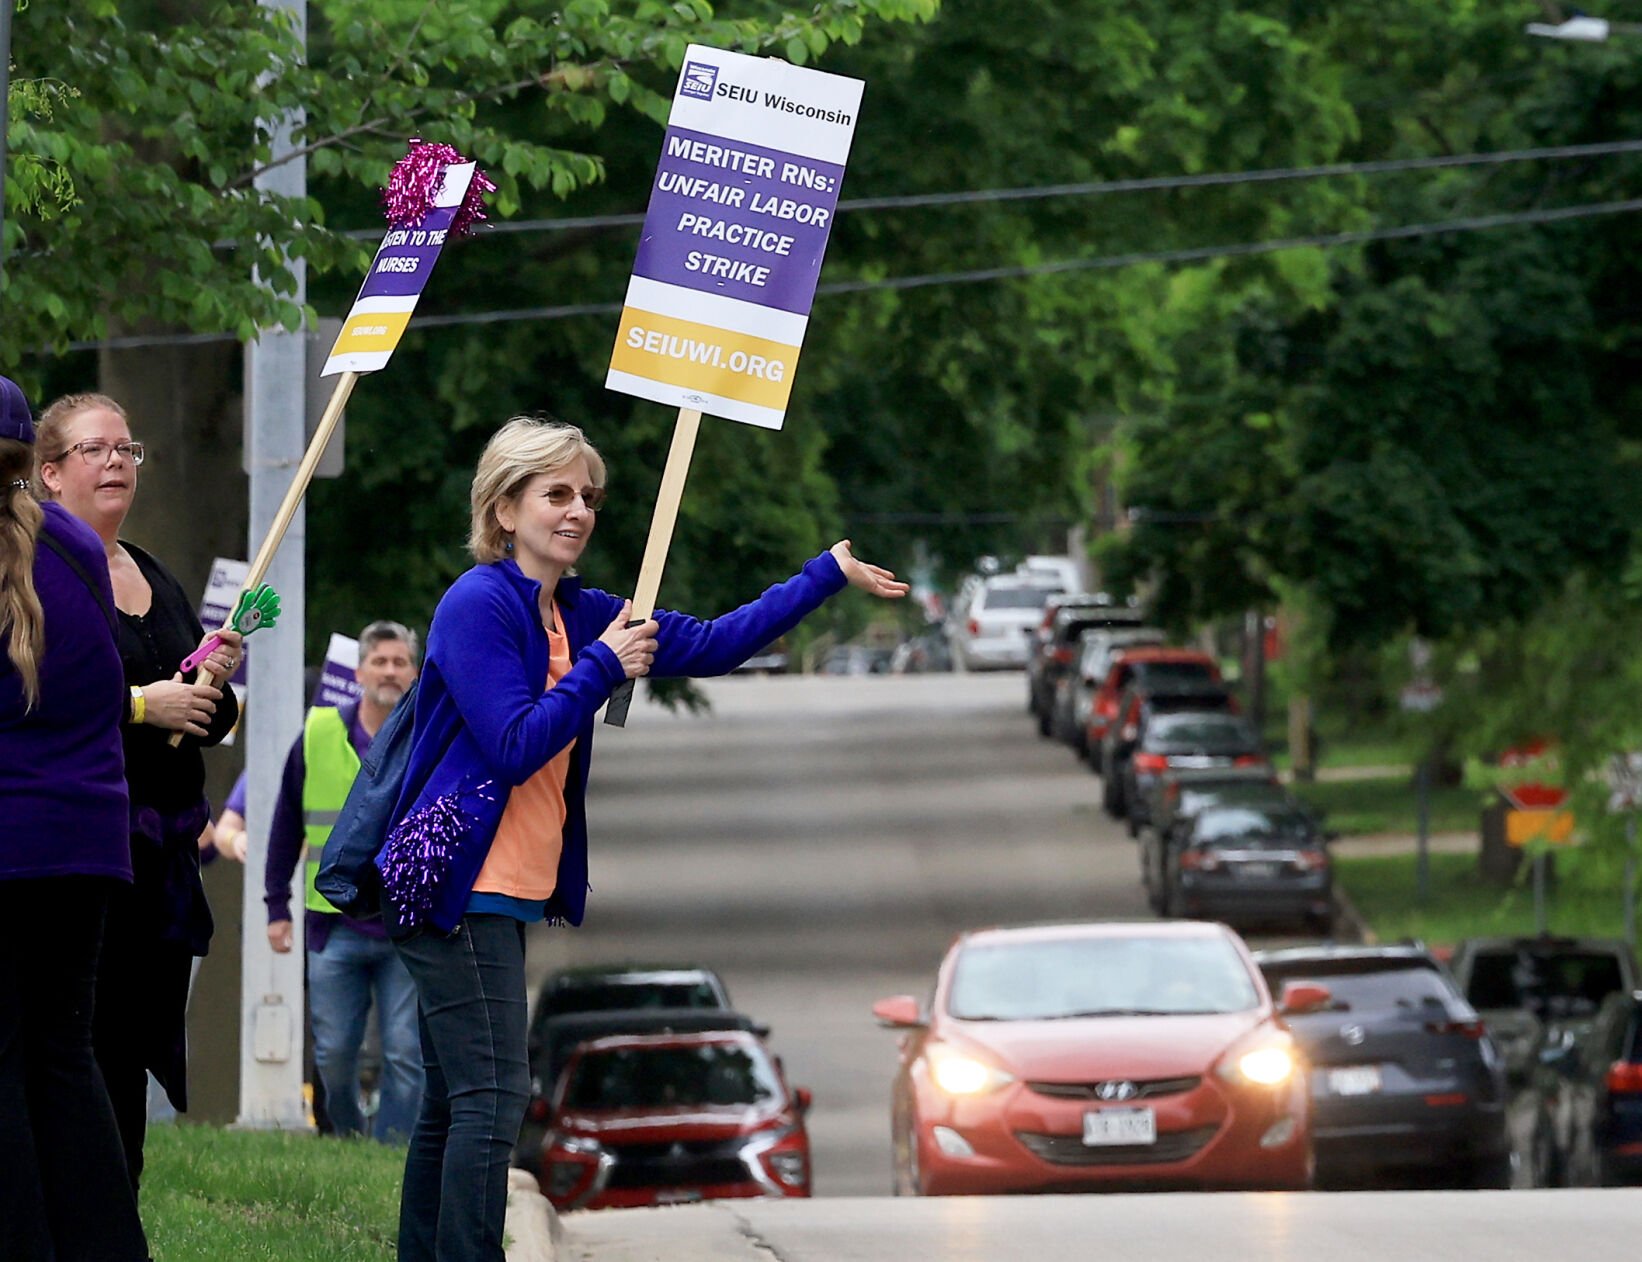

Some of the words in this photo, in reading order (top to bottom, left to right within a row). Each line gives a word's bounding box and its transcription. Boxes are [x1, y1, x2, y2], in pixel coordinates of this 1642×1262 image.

[716, 83, 758, 104] SEIU
[764, 92, 852, 126] Wisconsin
[667, 136, 776, 179] MERITER
[780, 163, 836, 193] RNs:
[658, 171, 746, 208] UNFAIR
[749, 193, 830, 228] LABOR
[410, 230, 427, 246] TO
[426, 229, 449, 246] THE
[677, 213, 795, 256] PRACTICE
[376, 257, 420, 274] NURSES
[684, 251, 771, 287] STRIKE
[626, 326, 785, 382] SEIUWI.ORG
